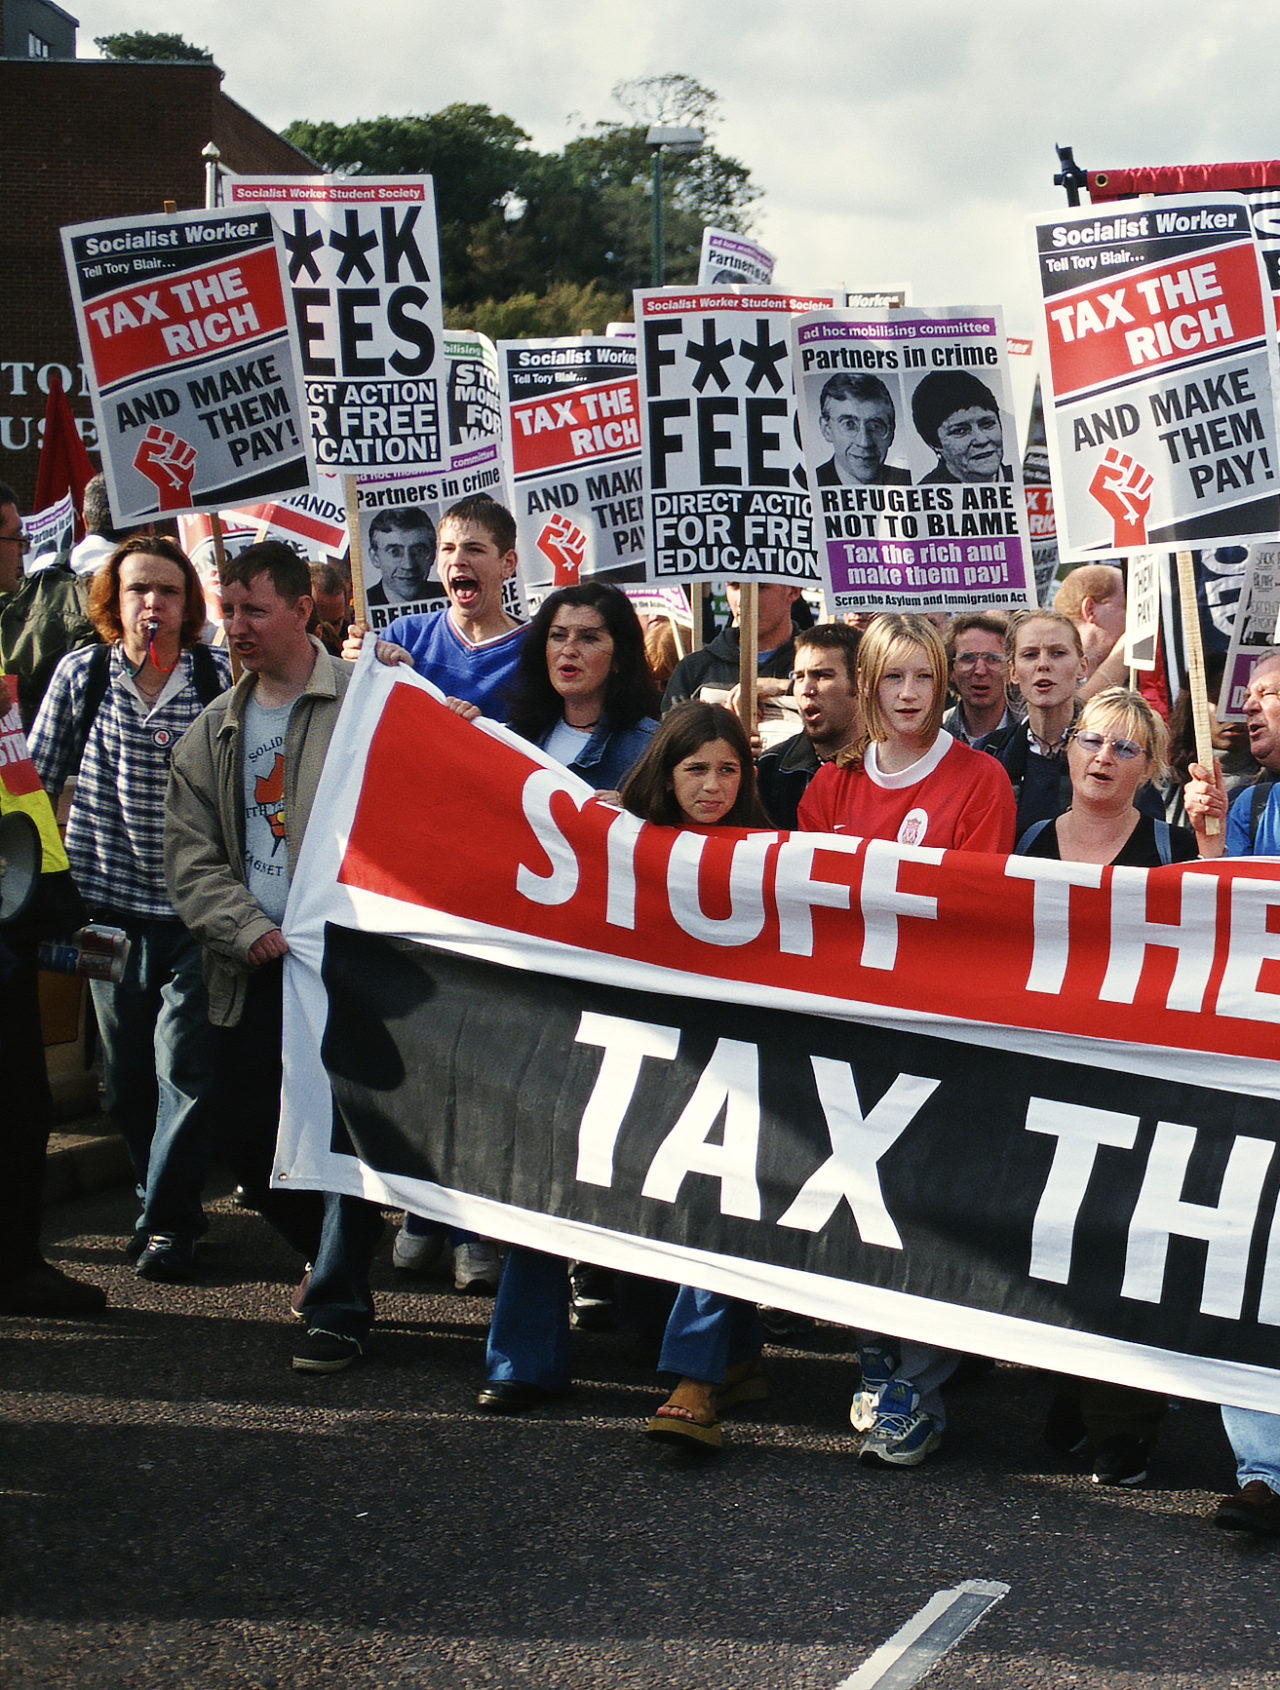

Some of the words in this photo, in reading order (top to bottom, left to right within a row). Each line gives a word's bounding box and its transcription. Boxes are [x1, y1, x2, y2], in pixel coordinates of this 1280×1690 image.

[236, 187, 287, 199] Socialist
[290, 188, 327, 199] Worker
[330, 189, 374, 199] Student
[377, 188, 420, 200] Society
[86, 230, 179, 256] Socialist
[185, 220, 258, 243] Worker
[1052, 216, 1148, 247] Socialist
[1156, 211, 1236, 233] Worker
[82, 265, 101, 279] Tell
[103, 261, 131, 276] Tory
[1046, 257, 1069, 272] Tell
[1071, 255, 1098, 271] Tory
[90, 291, 169, 339] TAX
[171, 268, 249, 312] THE
[647, 300, 696, 310] Socialist
[700, 298, 739, 308] Worker
[742, 298, 786, 308] Student
[790, 300, 830, 310] Society
[1051, 288, 1135, 342] TAX
[1138, 262, 1222, 314] THE
[162, 302, 260, 356] RICH
[803, 327, 819, 340] ad
[823, 325, 846, 336] hoc
[850, 325, 916, 338] mobilising
[920, 322, 990, 335] committee
[1125, 304, 1234, 364] RICH
[520, 351, 591, 366] Socialist
[802, 347, 898, 371] Partners
[903, 346, 926, 368] in
[932, 344, 997, 366] crime
[116, 390, 180, 432] AND
[186, 355, 282, 409] MAKE
[344, 383, 435, 404] ACTION
[513, 374, 530, 383] Tell
[532, 373, 552, 384] Tory
[198, 387, 290, 440] THEM
[339, 404, 436, 436] FREE
[514, 400, 578, 436] TAX
[580, 388, 634, 420] THE
[1074, 403, 1140, 451] AND
[1149, 368, 1256, 426] MAKE
[228, 420, 299, 467] PAY!
[570, 418, 639, 456] RICH
[1159, 408, 1265, 464] THEM
[357, 484, 438, 508] Partners
[442, 478, 459, 497] in
[463, 468, 499, 491] crime
[1189, 448, 1274, 498] PAY!
[528, 482, 578, 515] AND
[655, 492, 742, 516] DIRECT
[821, 488, 954, 513] REFUGEES
[962, 487, 1013, 509] ARE
[656, 514, 730, 548] FOR
[824, 514, 877, 538] NOT
[884, 514, 918, 538] TO
[927, 513, 1019, 537] BLAME
[843, 544, 878, 564] Tax
[881, 544, 914, 565] the
[920, 543, 962, 563] rich
[967, 542, 1006, 562] and
[848, 567, 902, 585] make
[906, 565, 961, 586] them
[964, 564, 1009, 586] pay!
[835, 595, 865, 607] Scrap
[868, 595, 884, 605] the
[886, 595, 921, 607] Asylum
[923, 594, 942, 604] and
[944, 593, 1009, 605] Immigration
[1011, 593, 1027, 603] Act
[516, 768, 946, 971] STUFF
[574, 1011, 941, 1249] TAX
